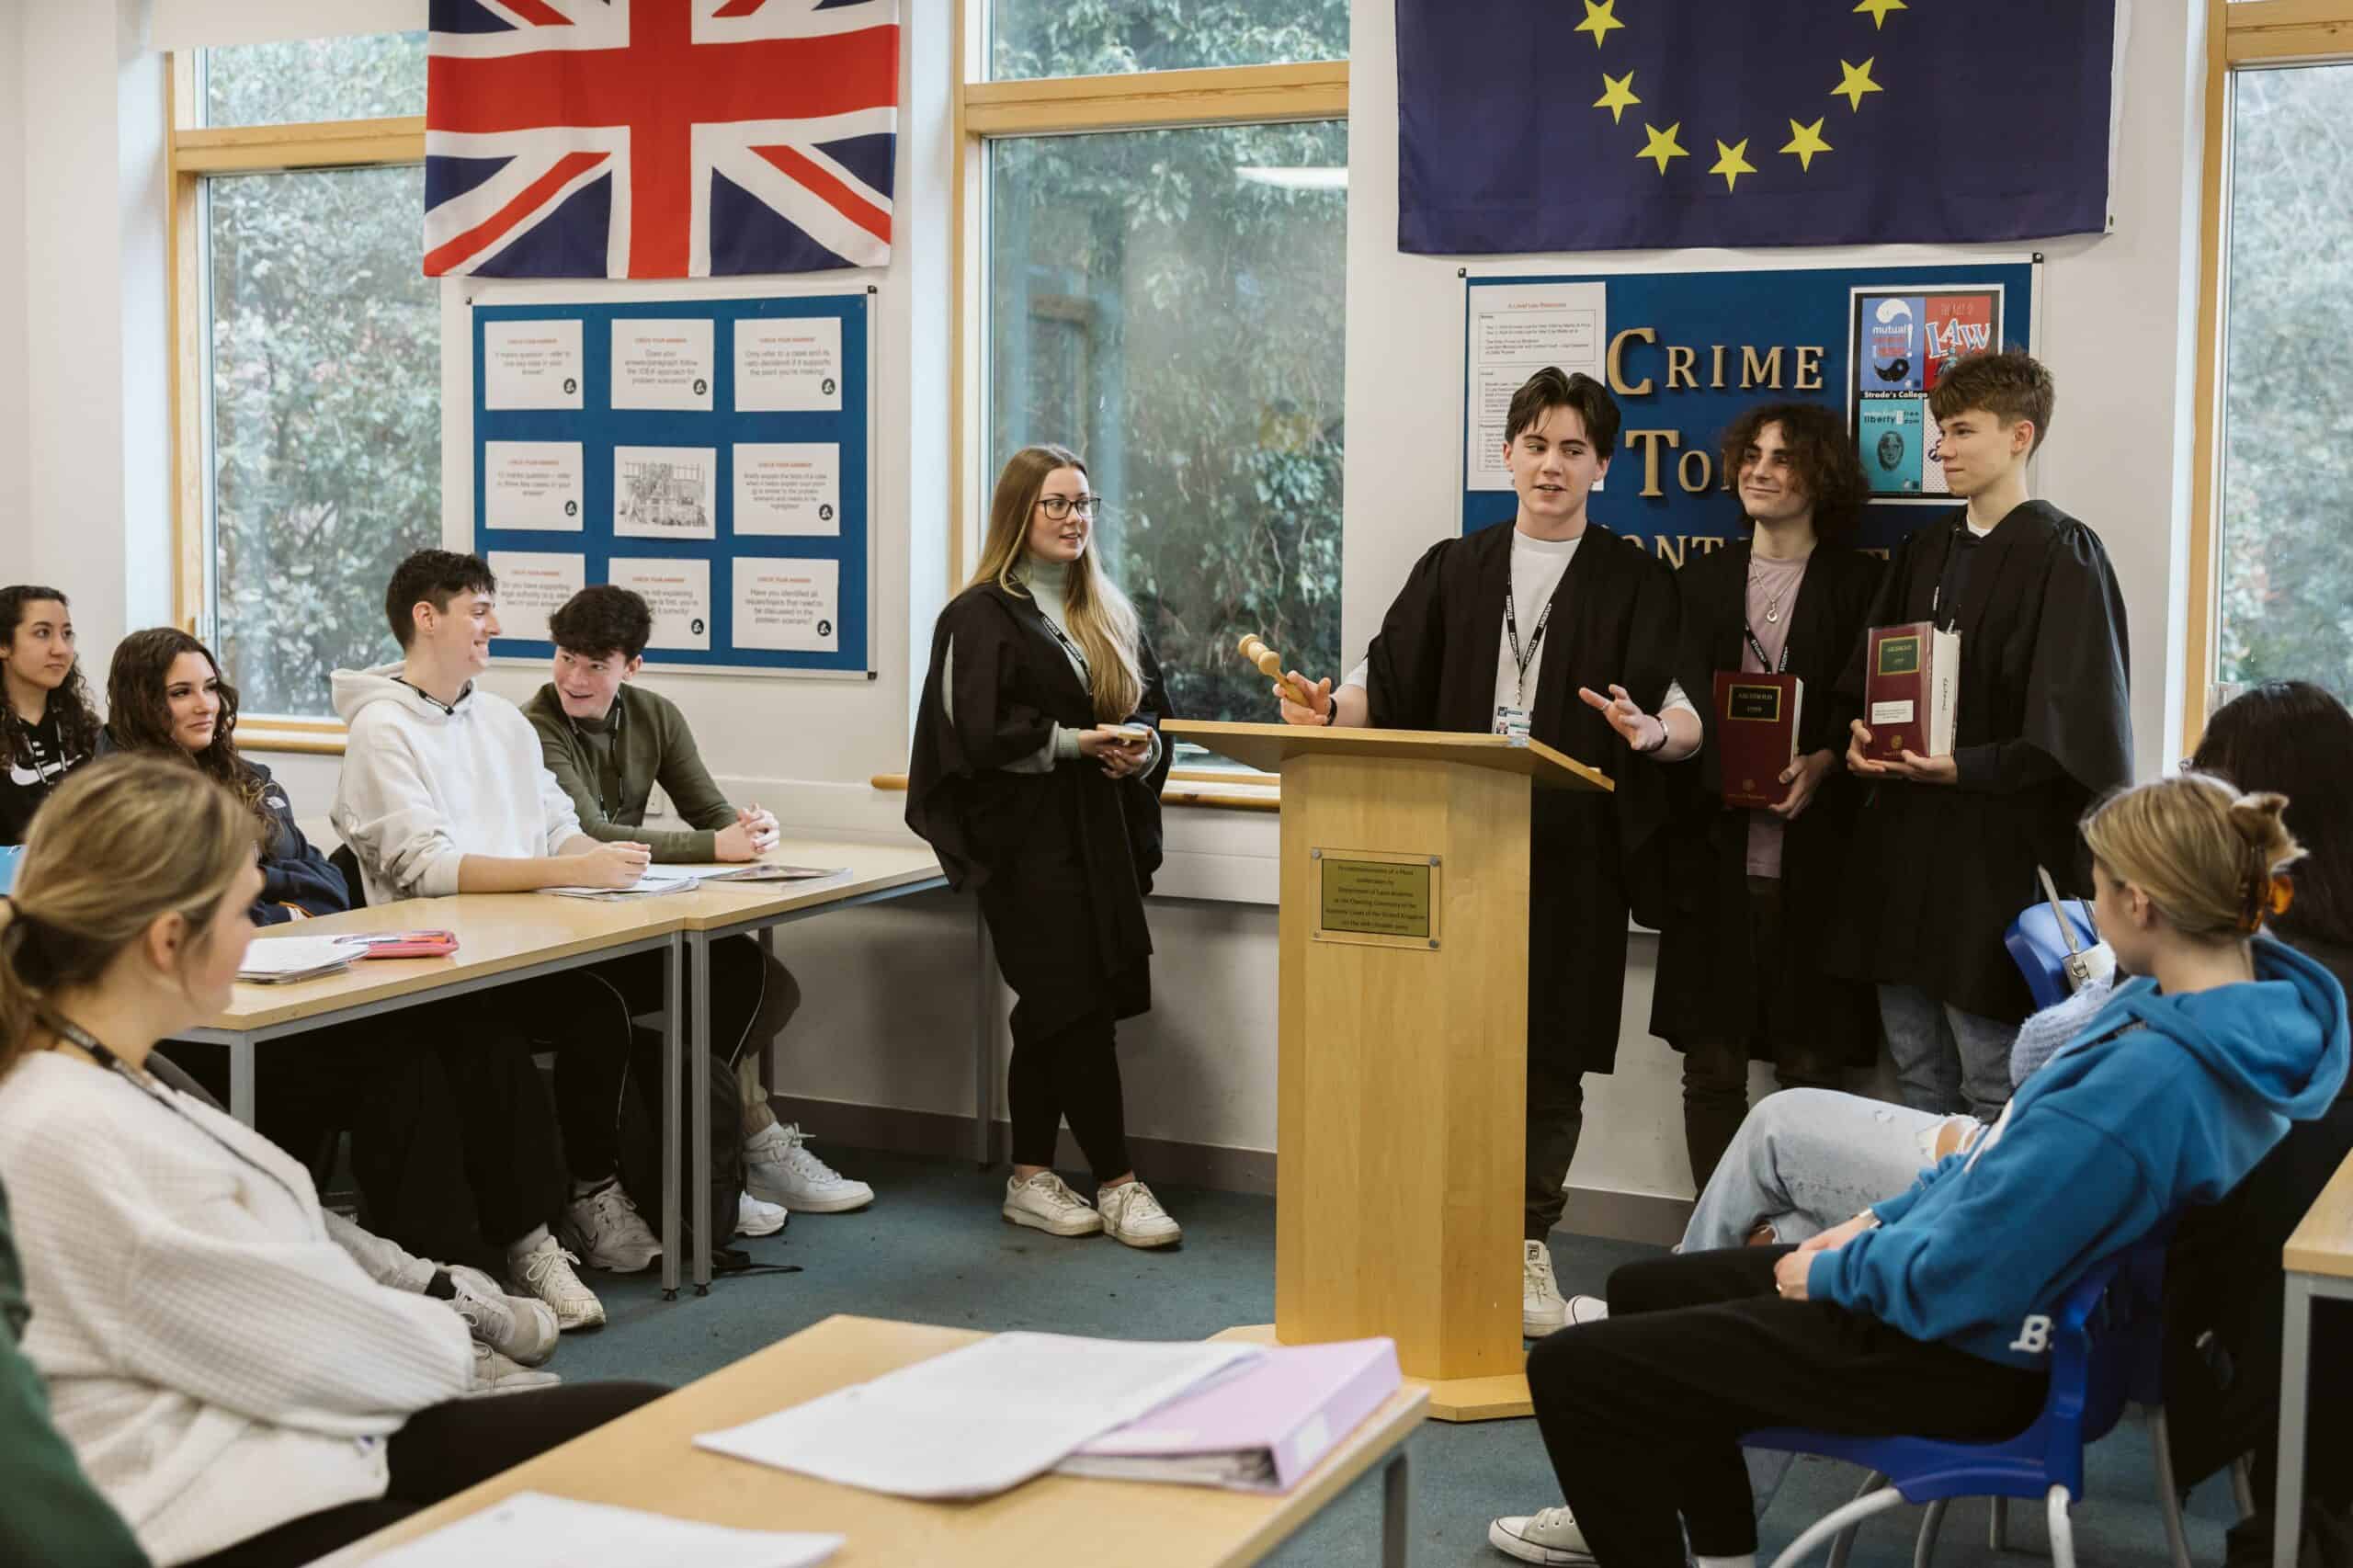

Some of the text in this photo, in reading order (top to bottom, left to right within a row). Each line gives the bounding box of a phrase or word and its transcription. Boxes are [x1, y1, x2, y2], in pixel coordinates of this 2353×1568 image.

[1607, 327, 1824, 396] CRIME
[1926, 318, 1991, 359] LAW
[1864, 415, 1896, 426] liberty
[1625, 429, 1732, 497] TO
